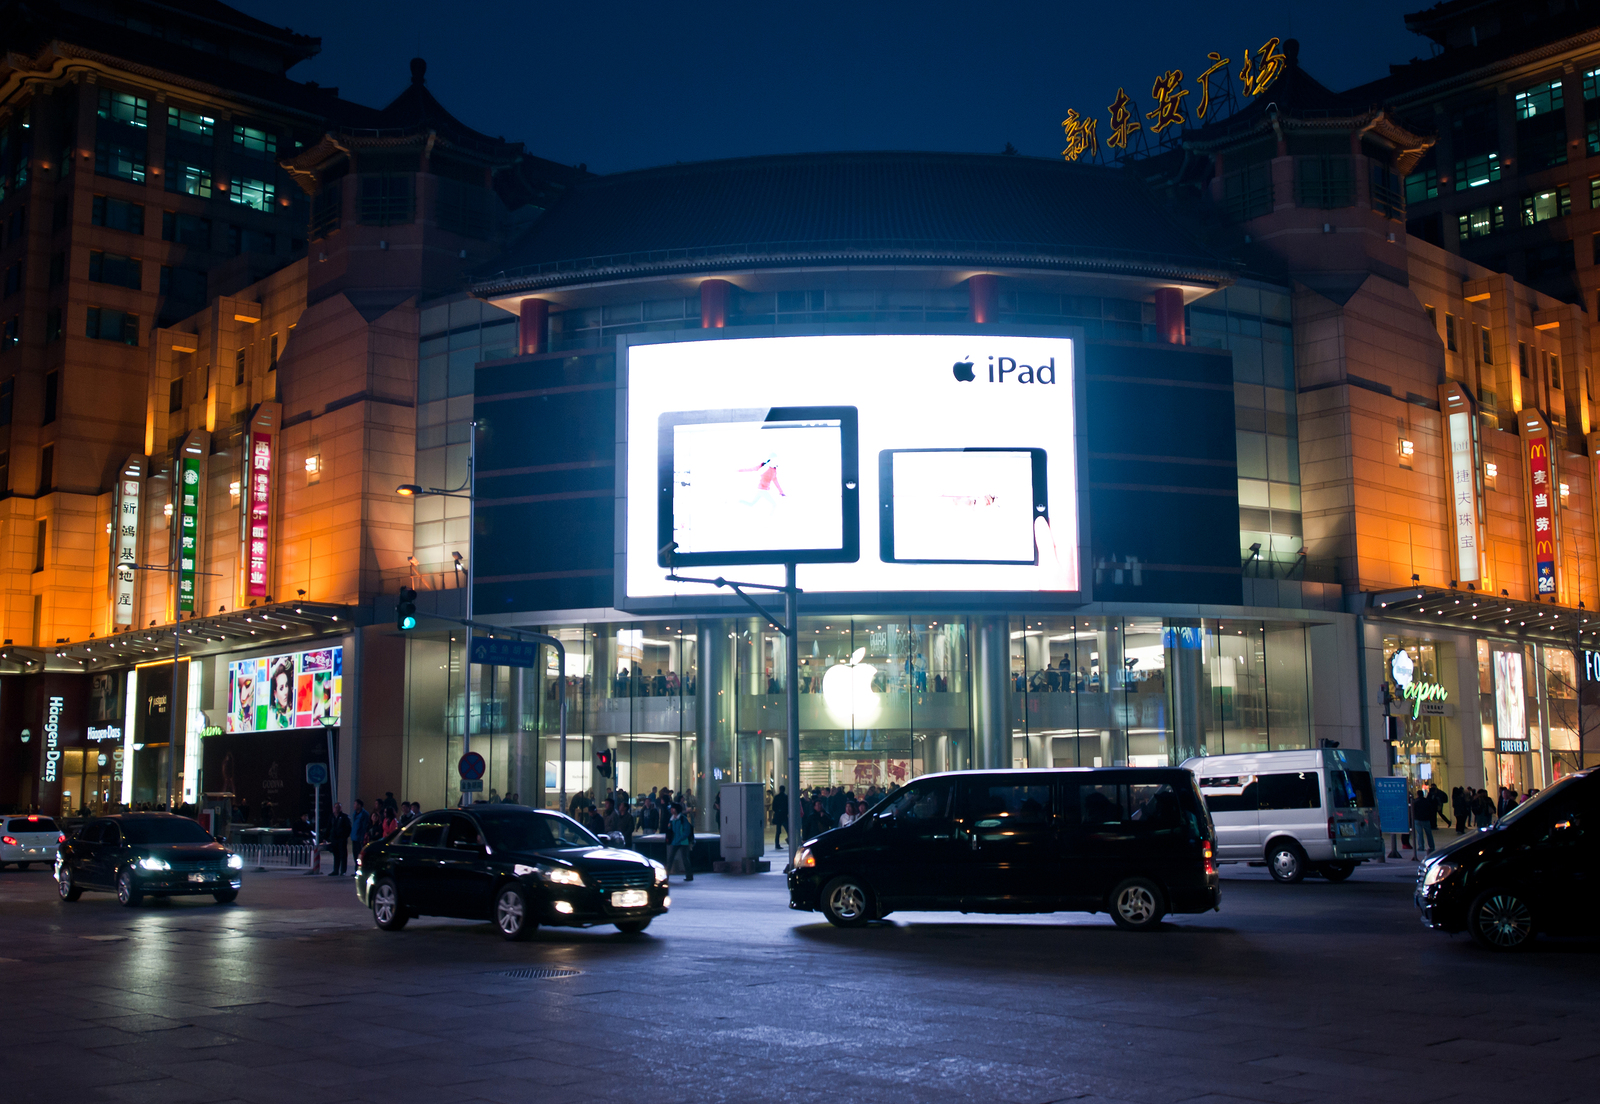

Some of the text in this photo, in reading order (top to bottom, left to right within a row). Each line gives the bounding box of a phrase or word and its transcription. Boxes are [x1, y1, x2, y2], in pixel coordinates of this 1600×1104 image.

[1061, 37, 1287, 161] 新东安广场
[988, 355, 1056, 385] iPad
[1455, 469, 1474, 549] 捷夫珠宝
[1533, 470, 1550, 532] 麦当劳
[181, 494, 196, 592] 星巴克咖啡
[1538, 576, 1555, 588] 24
[1403, 680, 1448, 719] apm
[1501, 740, 1523, 752] FOREVER
